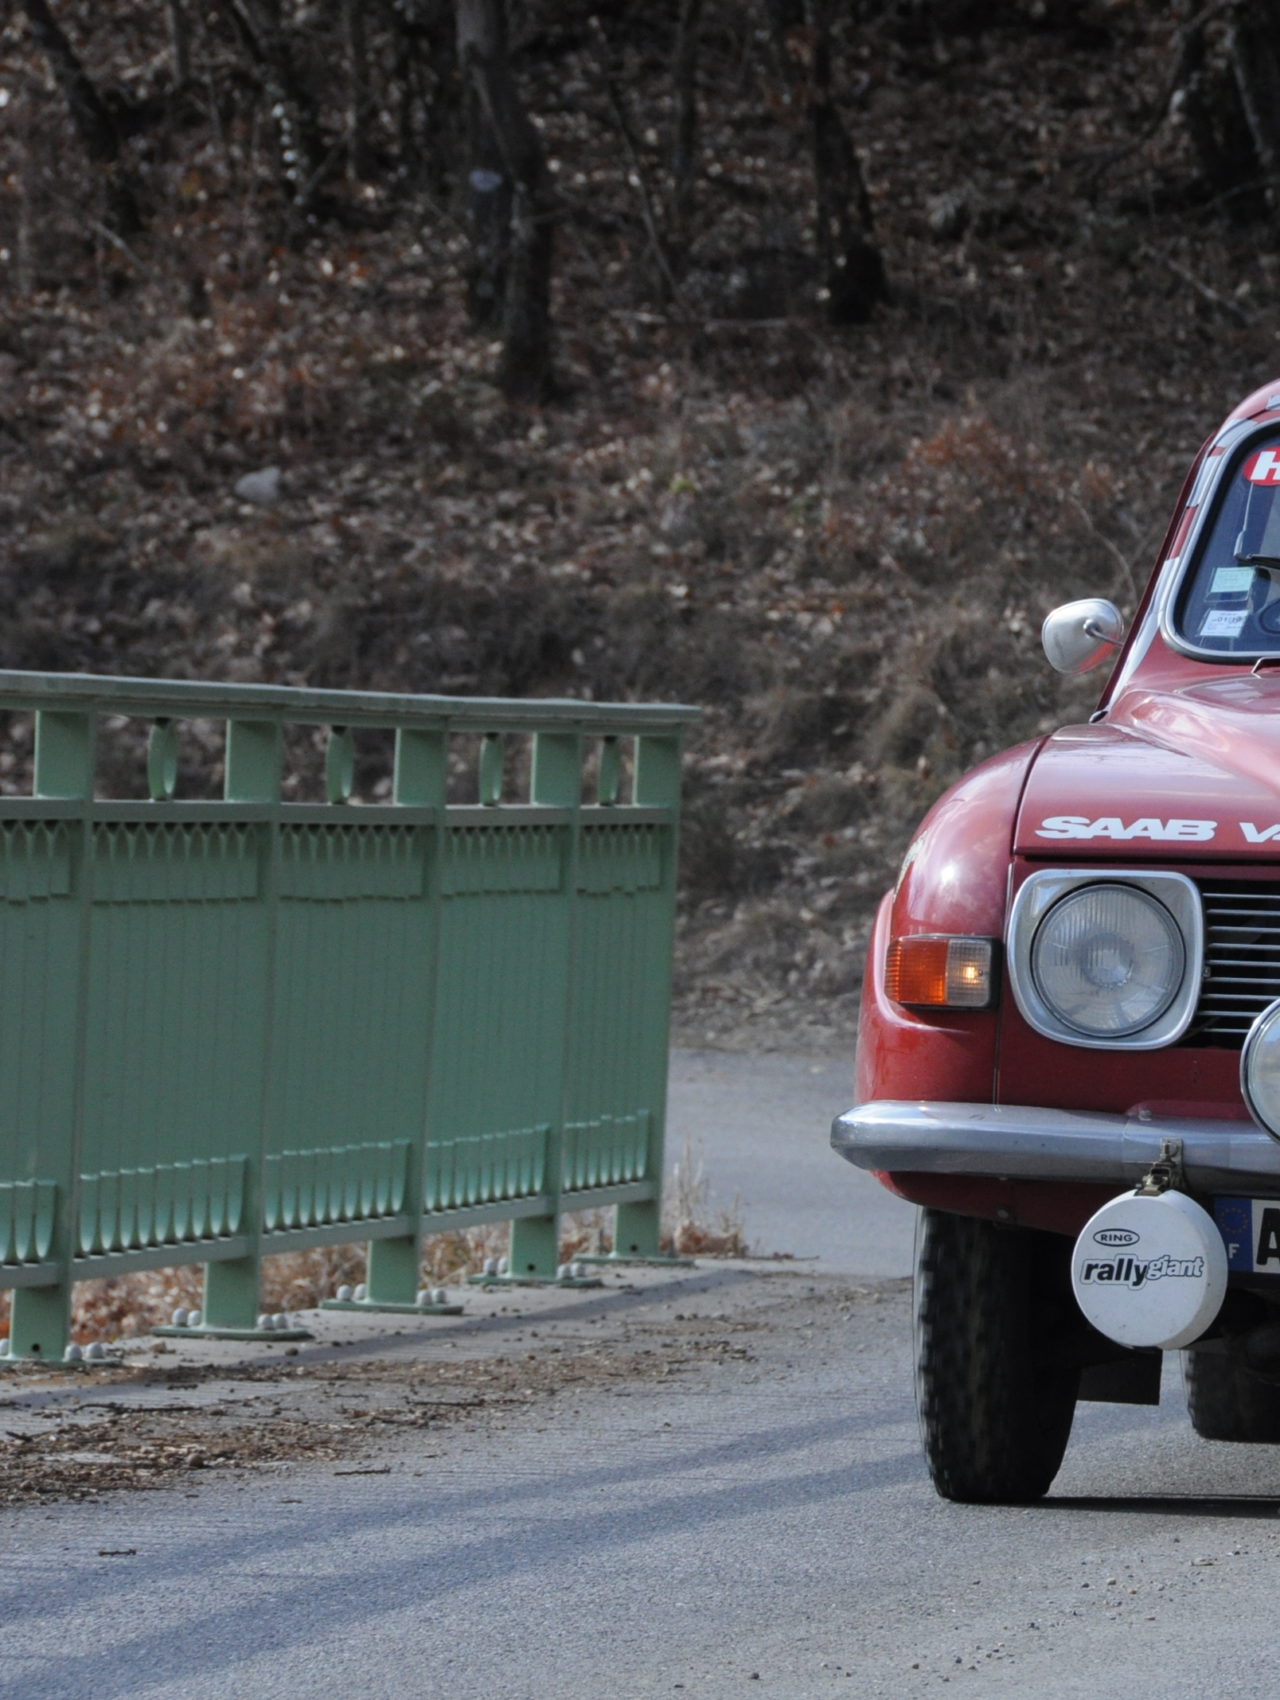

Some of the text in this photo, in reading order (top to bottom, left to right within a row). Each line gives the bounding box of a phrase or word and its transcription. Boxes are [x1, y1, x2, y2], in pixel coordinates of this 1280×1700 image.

[1035, 816, 1217, 843] SAAB
[1100, 1233, 1133, 1243] RING
[1228, 1243, 1240, 1258] F
